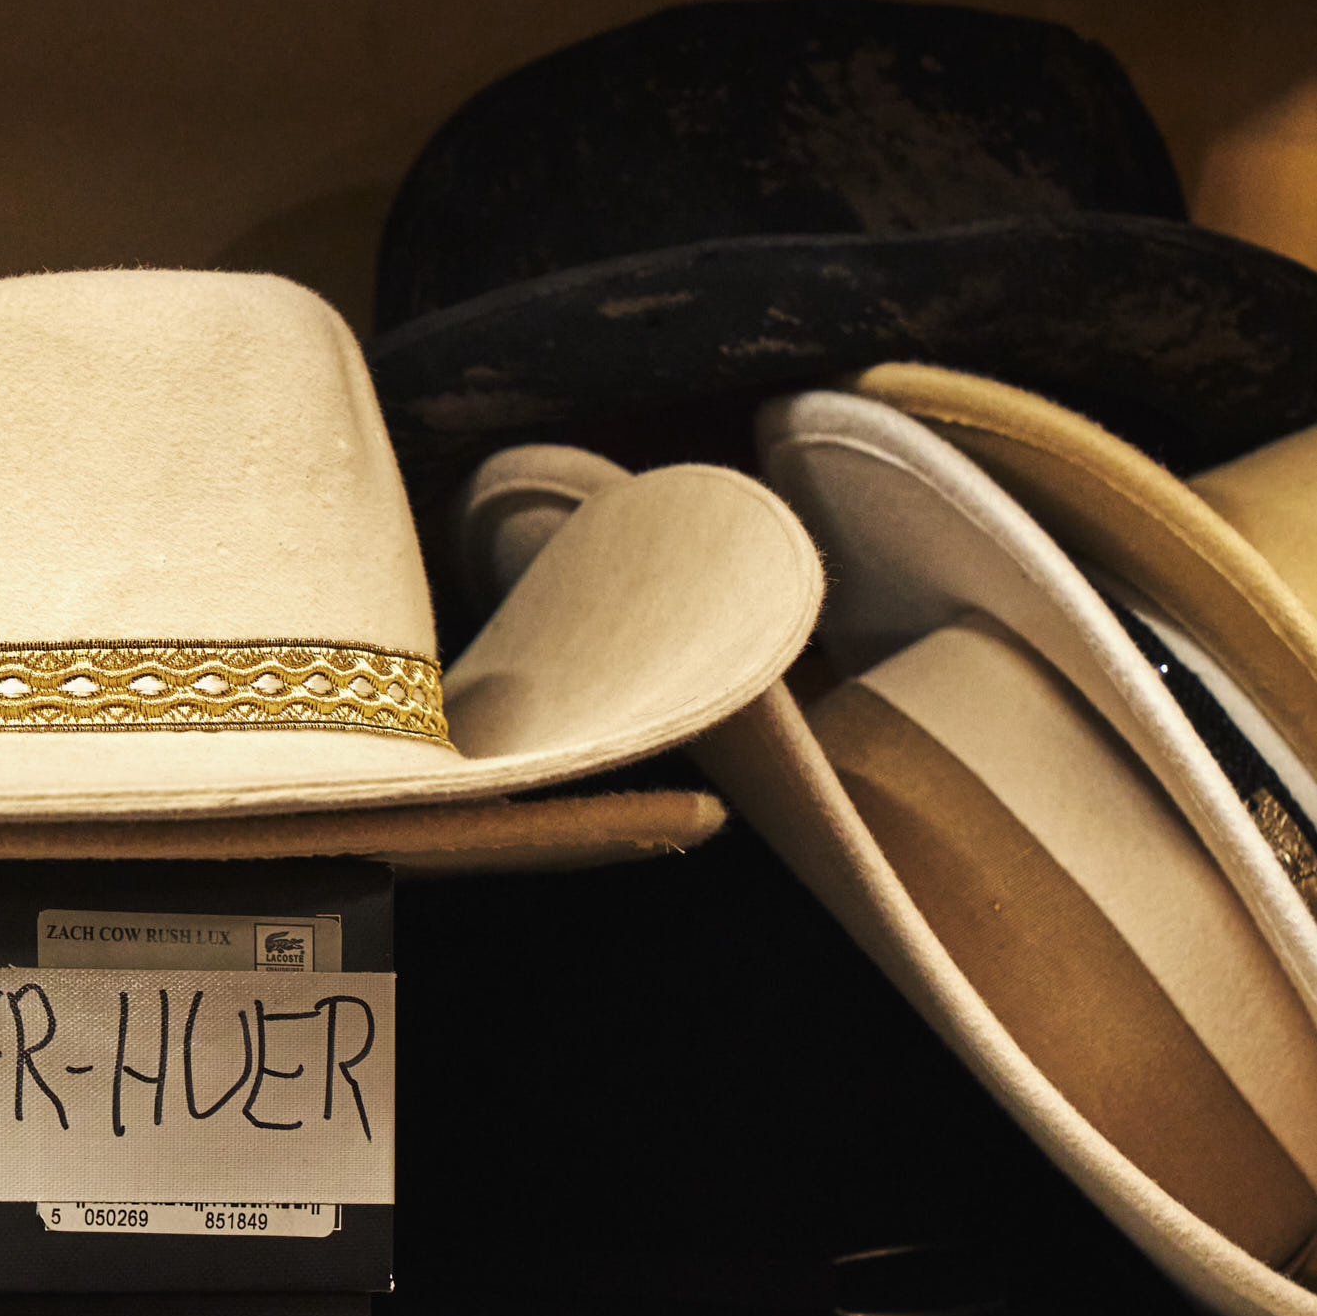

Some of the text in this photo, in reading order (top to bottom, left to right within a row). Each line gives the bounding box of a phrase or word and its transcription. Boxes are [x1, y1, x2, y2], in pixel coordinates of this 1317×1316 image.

[46, 924, 232, 945] ZACH COW RUSH LUX
[265, 954, 304, 963] LACOSTE
[51, 1208, 268, 1230] 5 050269 851849
